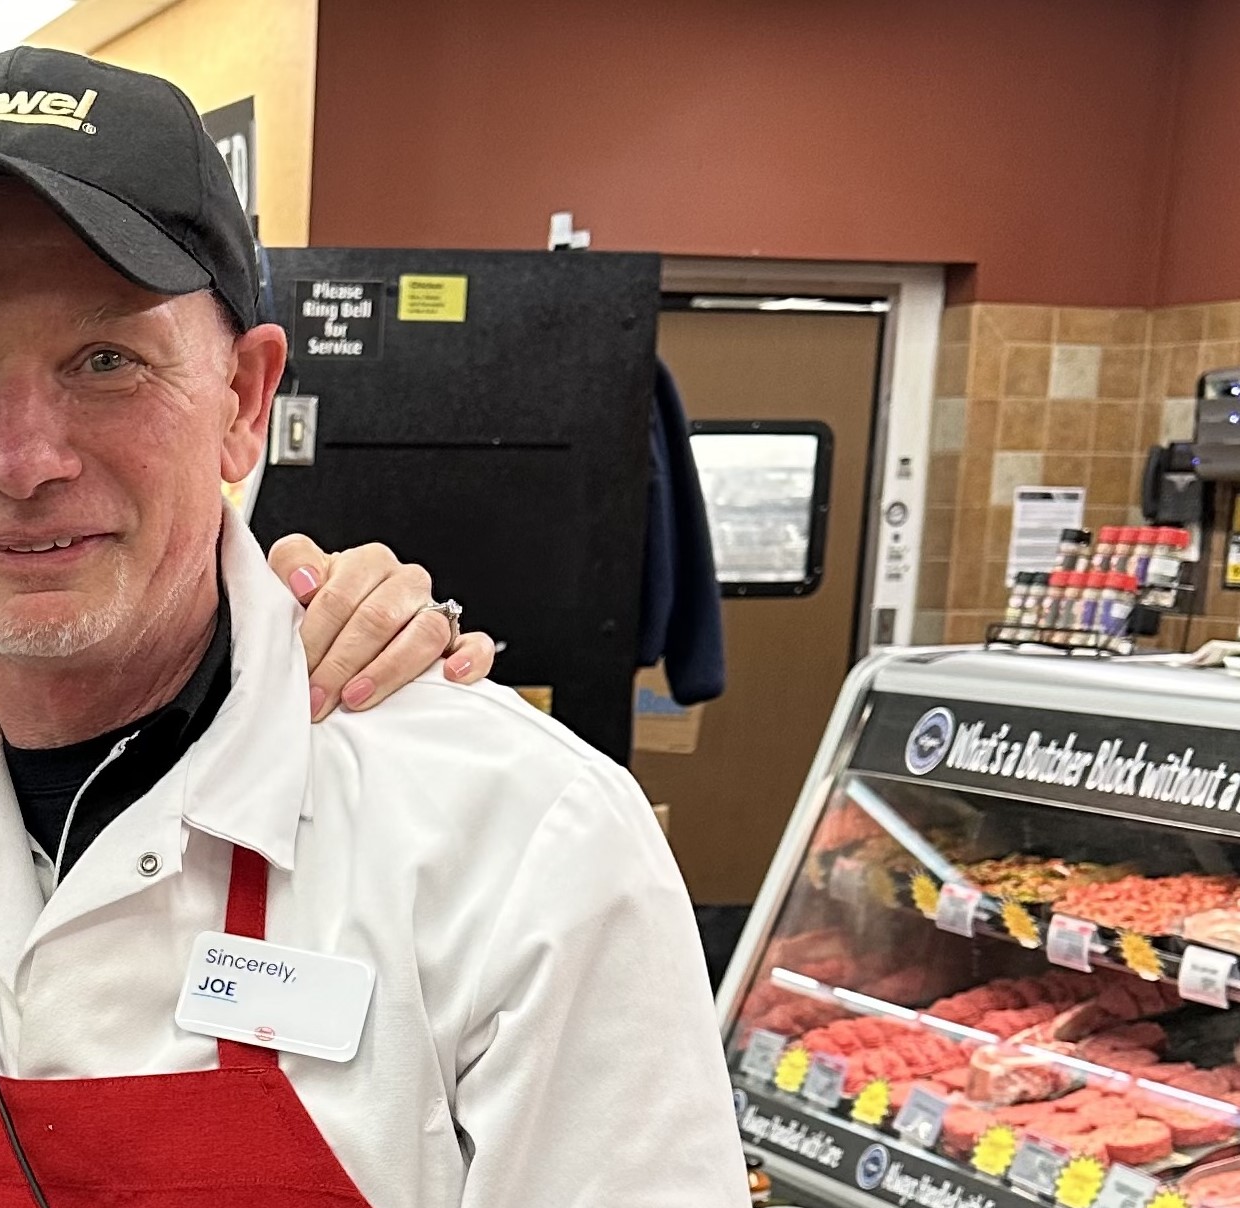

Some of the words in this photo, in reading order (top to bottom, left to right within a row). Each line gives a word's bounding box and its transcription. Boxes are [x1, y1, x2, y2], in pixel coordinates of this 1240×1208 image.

[312, 281, 364, 299] Please
[302, 301, 339, 321] Ring
[340, 300, 372, 318] Bell
[324, 319, 348, 337] for
[308, 338, 363, 355] Service
[946, 720, 1010, 775] What's
[1001, 742, 1023, 777] a
[1015, 730, 1094, 787] Butcher
[1085, 738, 1148, 796] Block
[1139, 747, 1227, 809] without
[206, 948, 297, 983] Sincerely,
[198, 976, 238, 996] JOE
